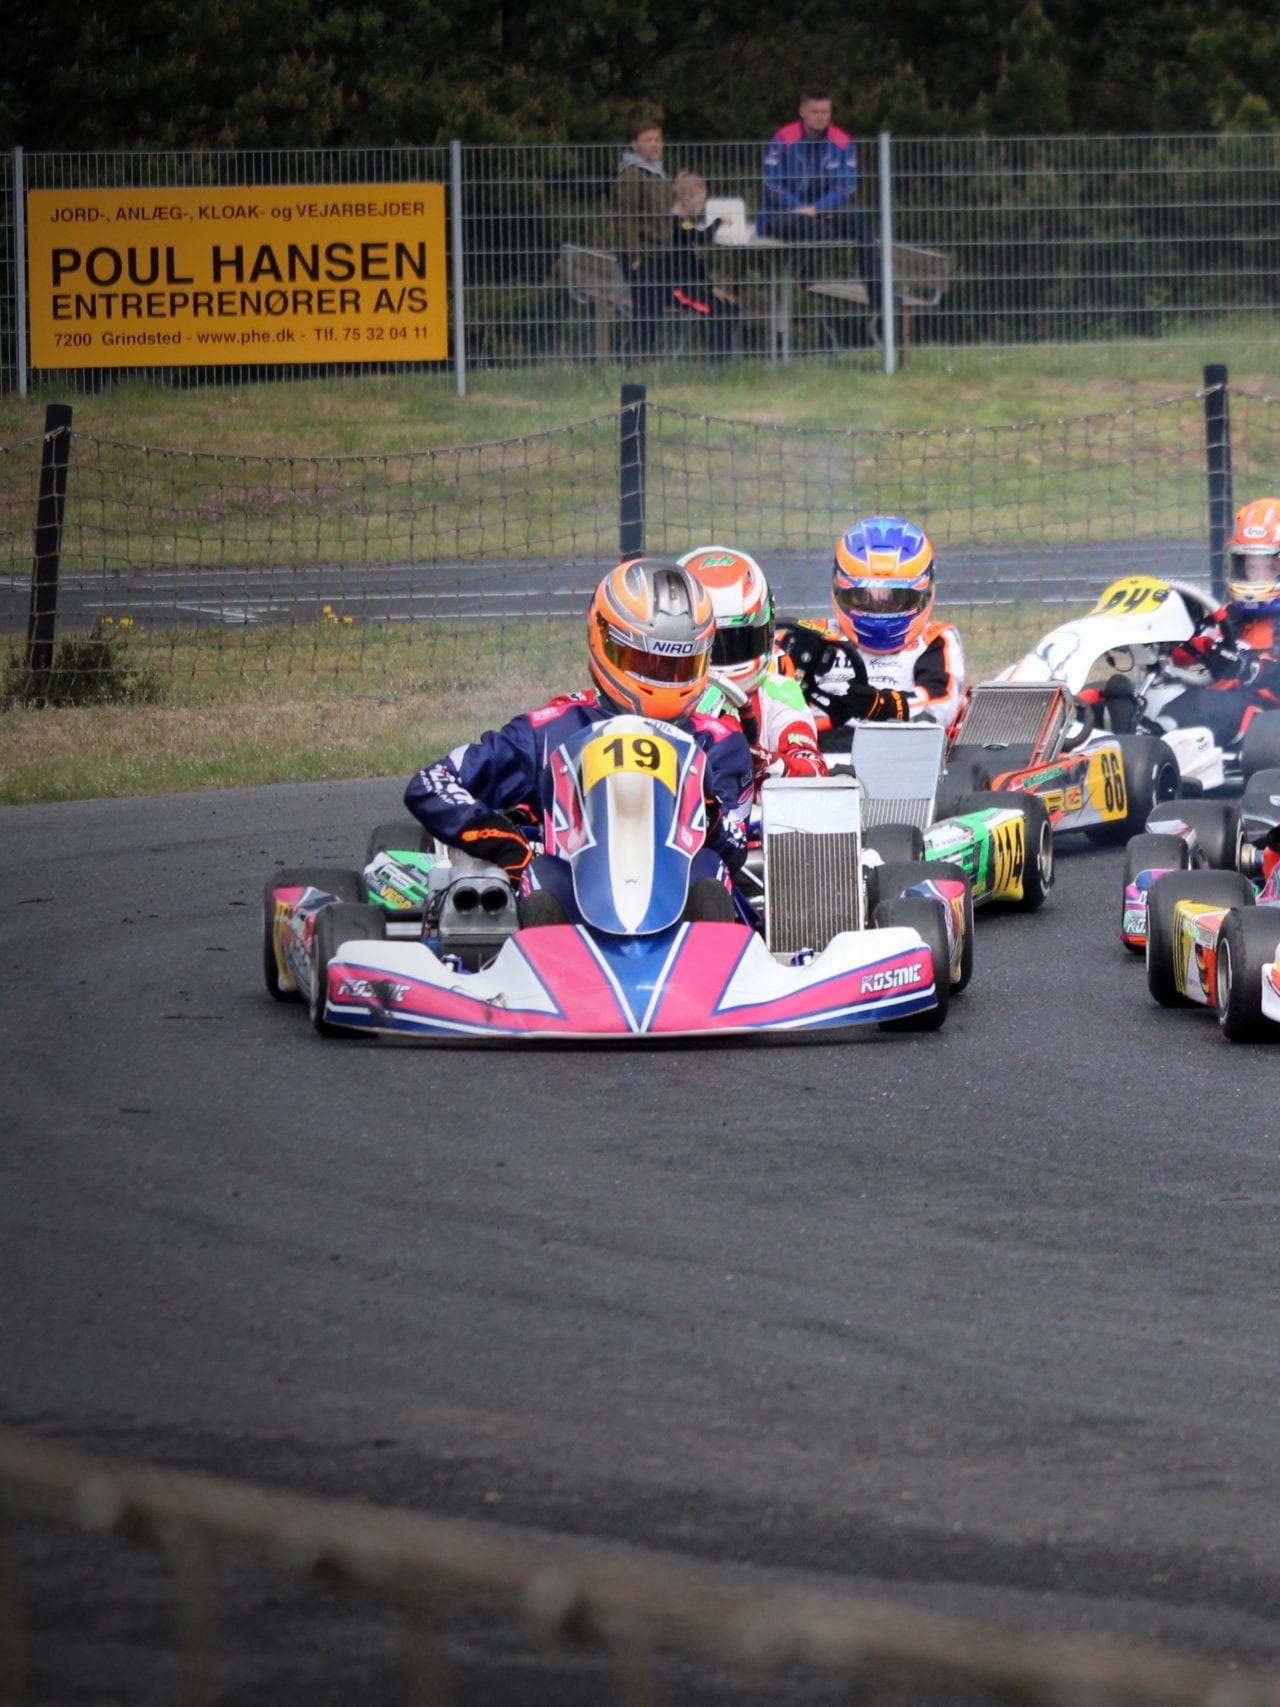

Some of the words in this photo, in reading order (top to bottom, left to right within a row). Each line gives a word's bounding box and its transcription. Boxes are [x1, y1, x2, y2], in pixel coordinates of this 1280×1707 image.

[50, 207, 110, 223] JORD-,
[115, 206, 194, 222] ANLÆG-,
[199, 204, 266, 220] KLOAK-
[271, 207, 292, 222] og
[296, 202, 425, 218] VEJARBEJDER
[51, 246, 194, 288] POUL
[212, 241, 427, 284] HANSEN
[52, 288, 361, 320] ENTREPRENØRER
[373, 286, 428, 315] A/S
[54, 333, 92, 347] 7200
[102, 331, 182, 346] Grindsted
[197, 328, 295, 345] www.phe.dk
[314, 328, 338, 341] Tlf.
[343, 328, 361, 341] 75
[366, 328, 384, 341] 32
[389, 327, 408, 340] 04
[414, 327, 427, 339] 11
[652, 641, 694, 654] NIRO
[602, 738, 661, 771] 19
[1100, 752, 1126, 813] 86
[995, 822, 1022, 893] 114
[337, 978, 411, 1002] KOSIC
[861, 963, 923, 995] KOSMIC
